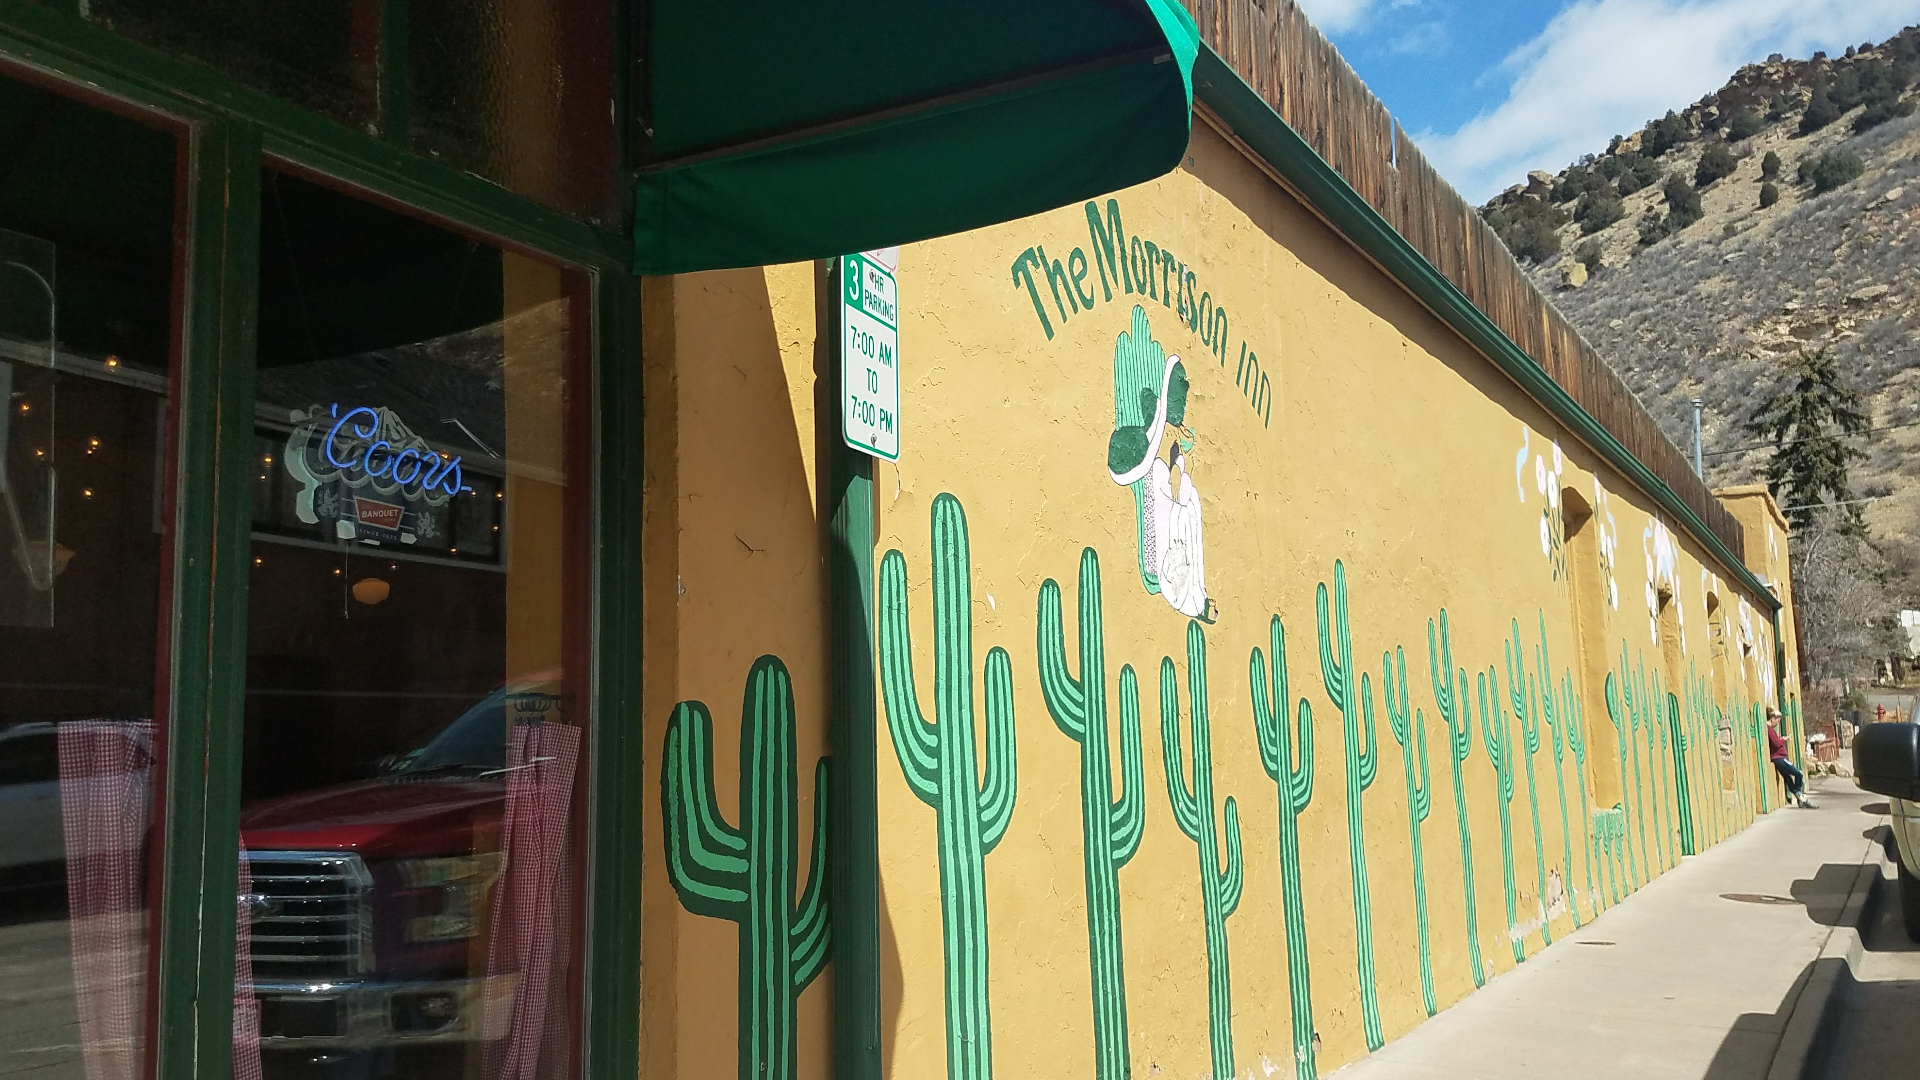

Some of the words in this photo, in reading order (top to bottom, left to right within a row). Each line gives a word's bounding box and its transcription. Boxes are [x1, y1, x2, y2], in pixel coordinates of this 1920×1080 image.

[849, 260, 860, 301] 3
[874, 274, 885, 295] HR
[1011, 244, 1095, 341] The
[1084, 198, 1228, 368] Morrison
[864, 289, 894, 322] PARKING
[851, 325, 875, 360] 7:00
[878, 341, 893, 369] AM
[866, 367, 878, 394] TO
[851, 395, 876, 428] 7:00
[879, 408, 893, 434] PM
[327, 403, 470, 496] Coors
[361, 509, 399, 518] BANQUET
